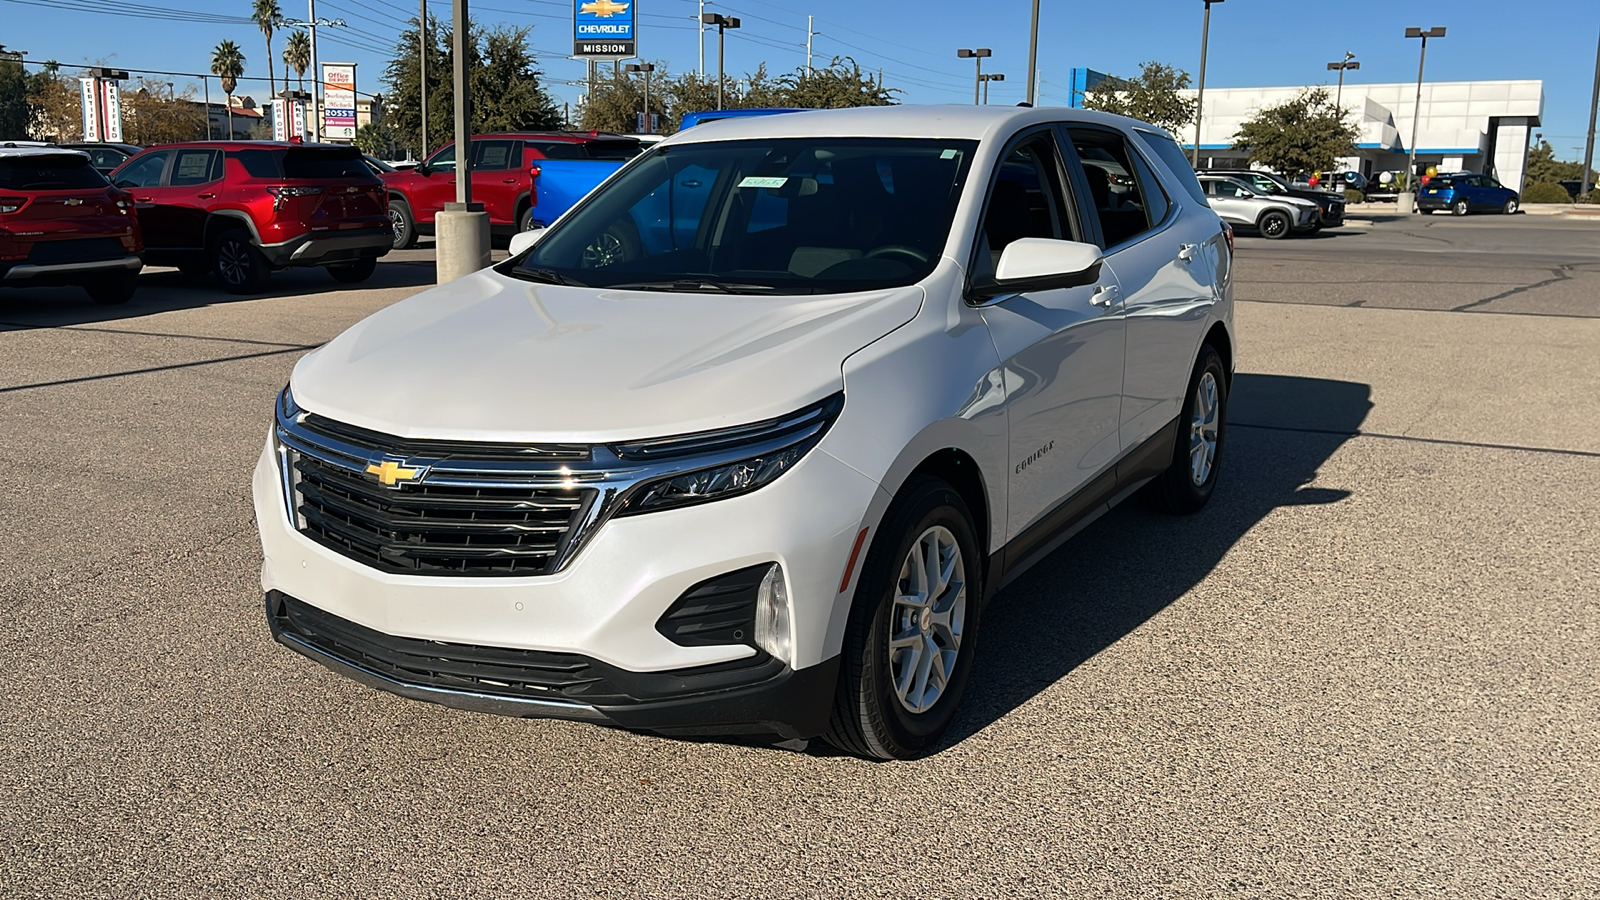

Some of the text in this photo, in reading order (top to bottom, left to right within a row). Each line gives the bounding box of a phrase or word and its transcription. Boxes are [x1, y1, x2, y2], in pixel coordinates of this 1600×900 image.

[579, 25, 630, 33] CHEVROLET
[583, 44, 626, 52] MISSION
[86, 81, 95, 138] CERTIFIED
[109, 82, 118, 139] CERTIFIED
[1015, 440, 1054, 474] EQUINOX
